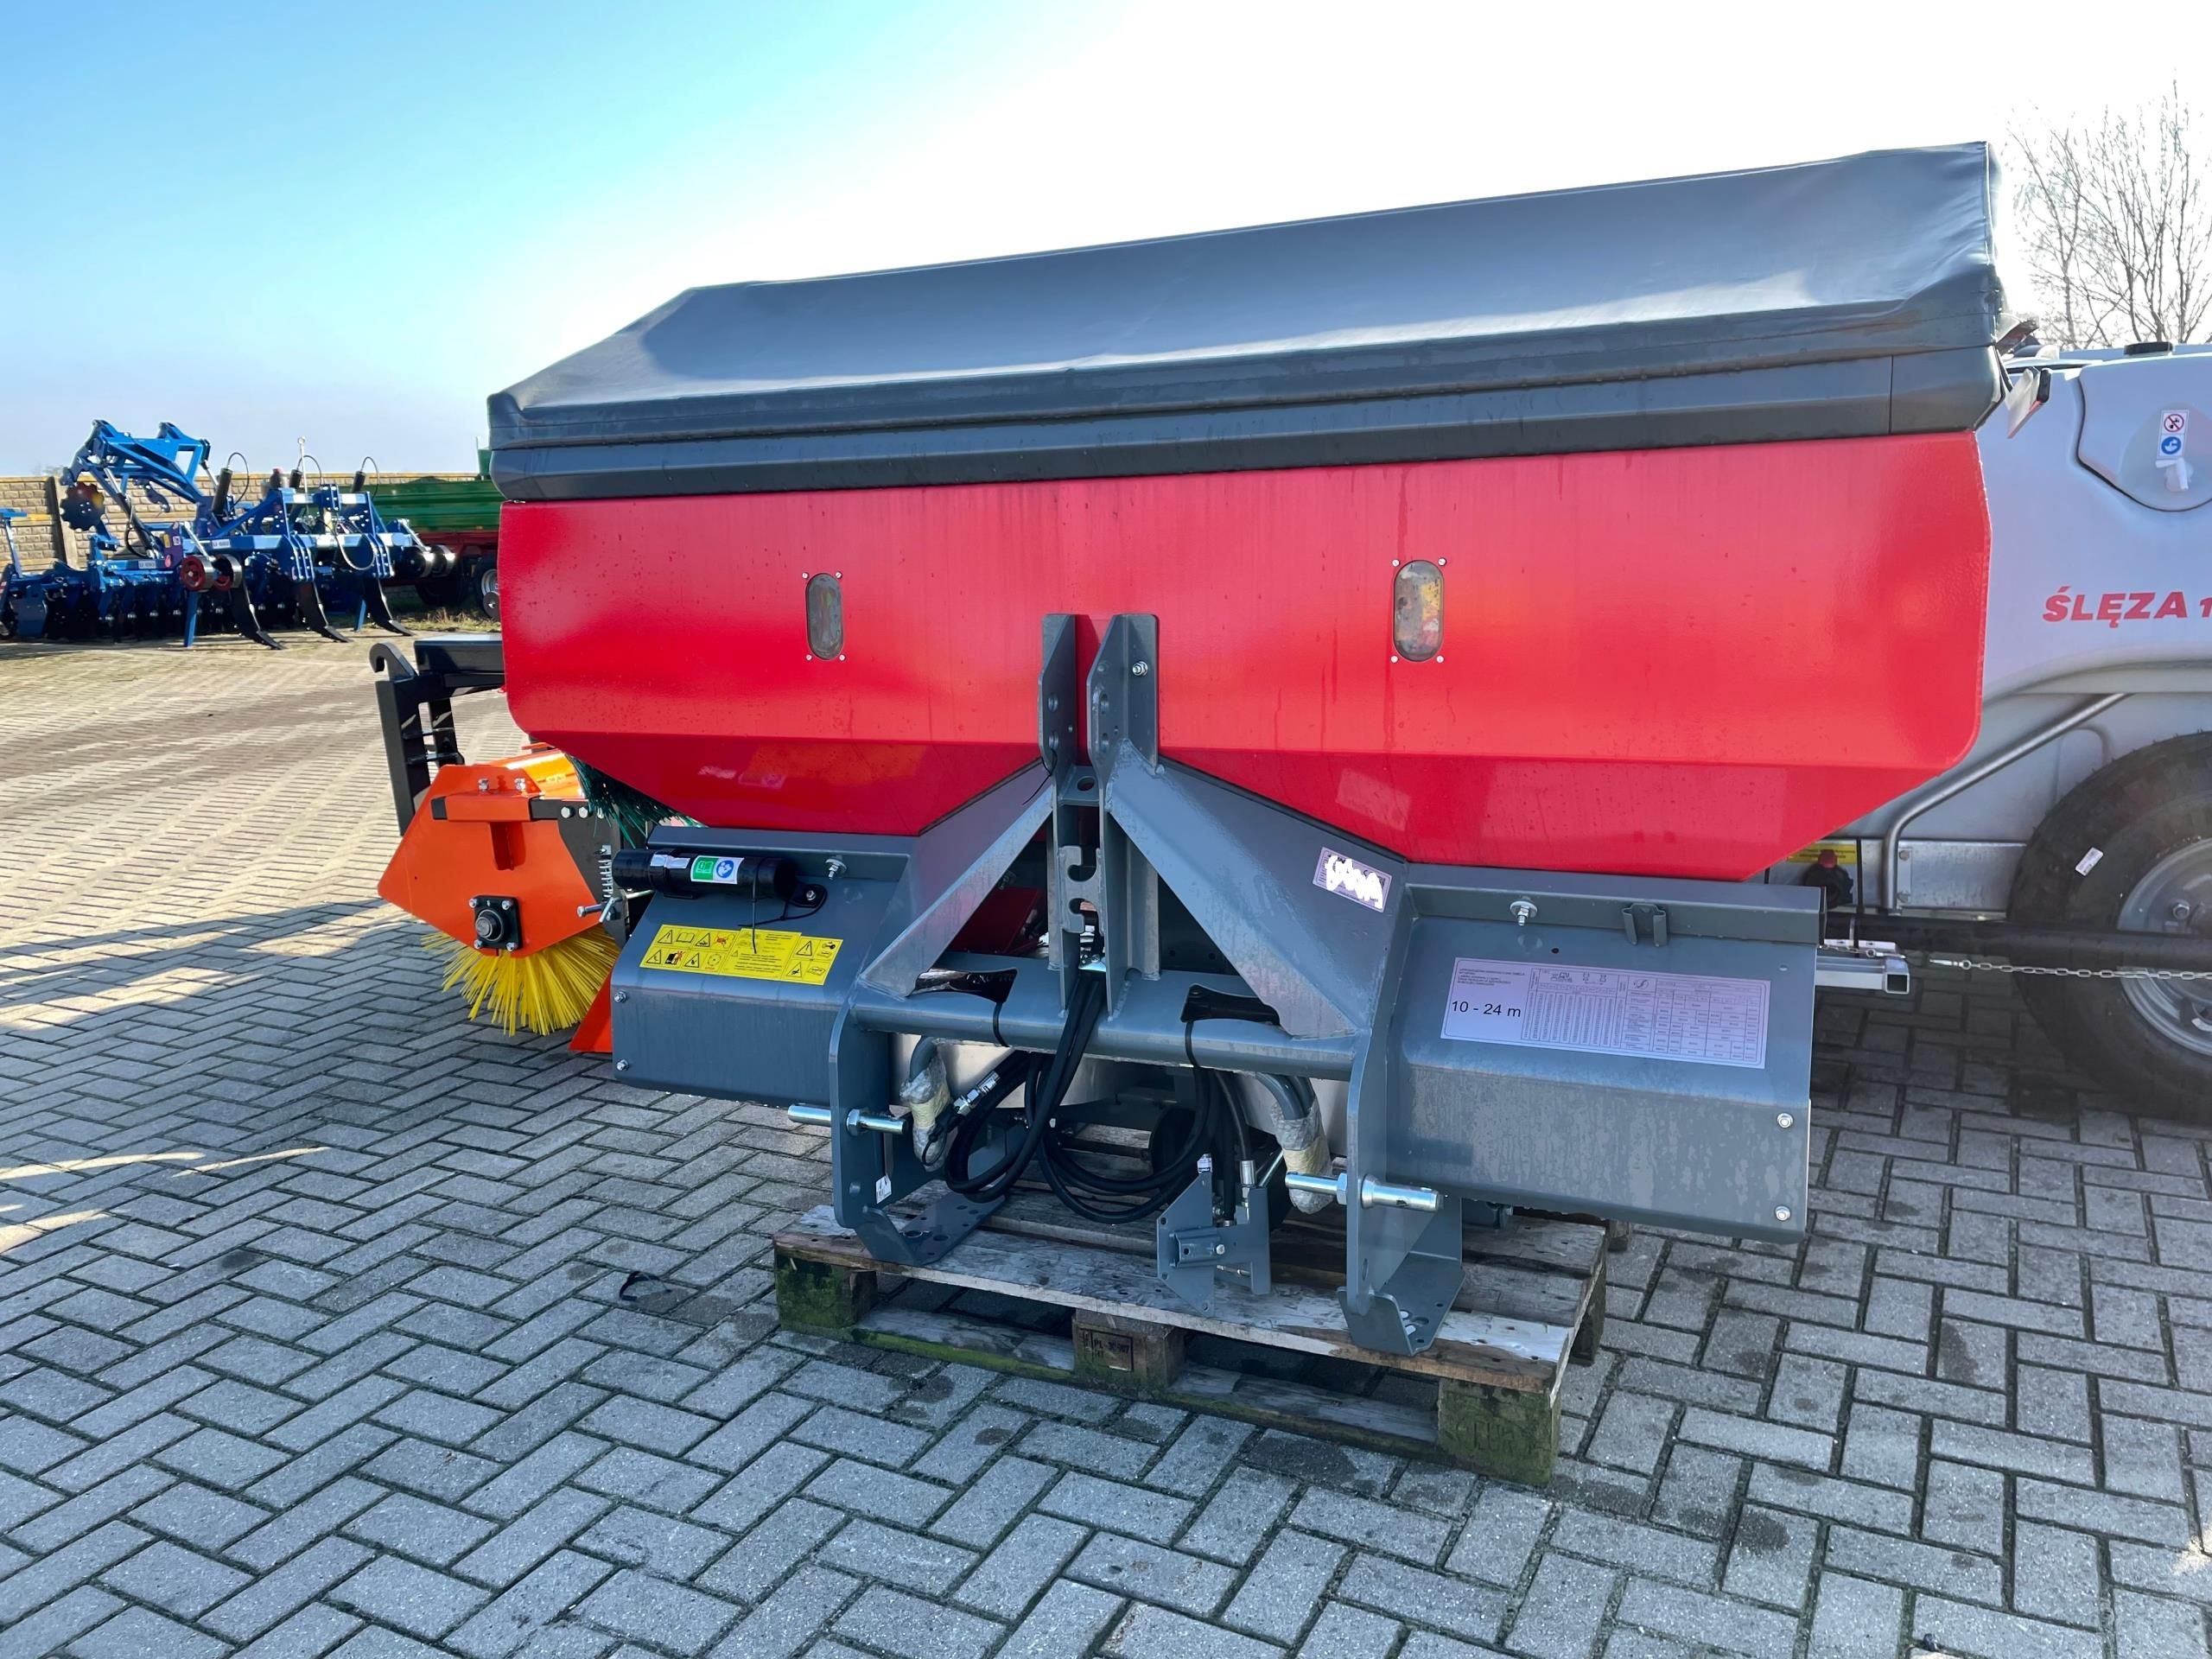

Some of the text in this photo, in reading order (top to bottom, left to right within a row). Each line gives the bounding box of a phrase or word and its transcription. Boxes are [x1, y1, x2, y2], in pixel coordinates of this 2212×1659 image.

[2042, 586, 2188, 628] ŚLĘZA
[1452, 1001, 1469, 1013] 10
[1483, 1003, 1502, 1015] 24
[1507, 1007, 1521, 1017] m
